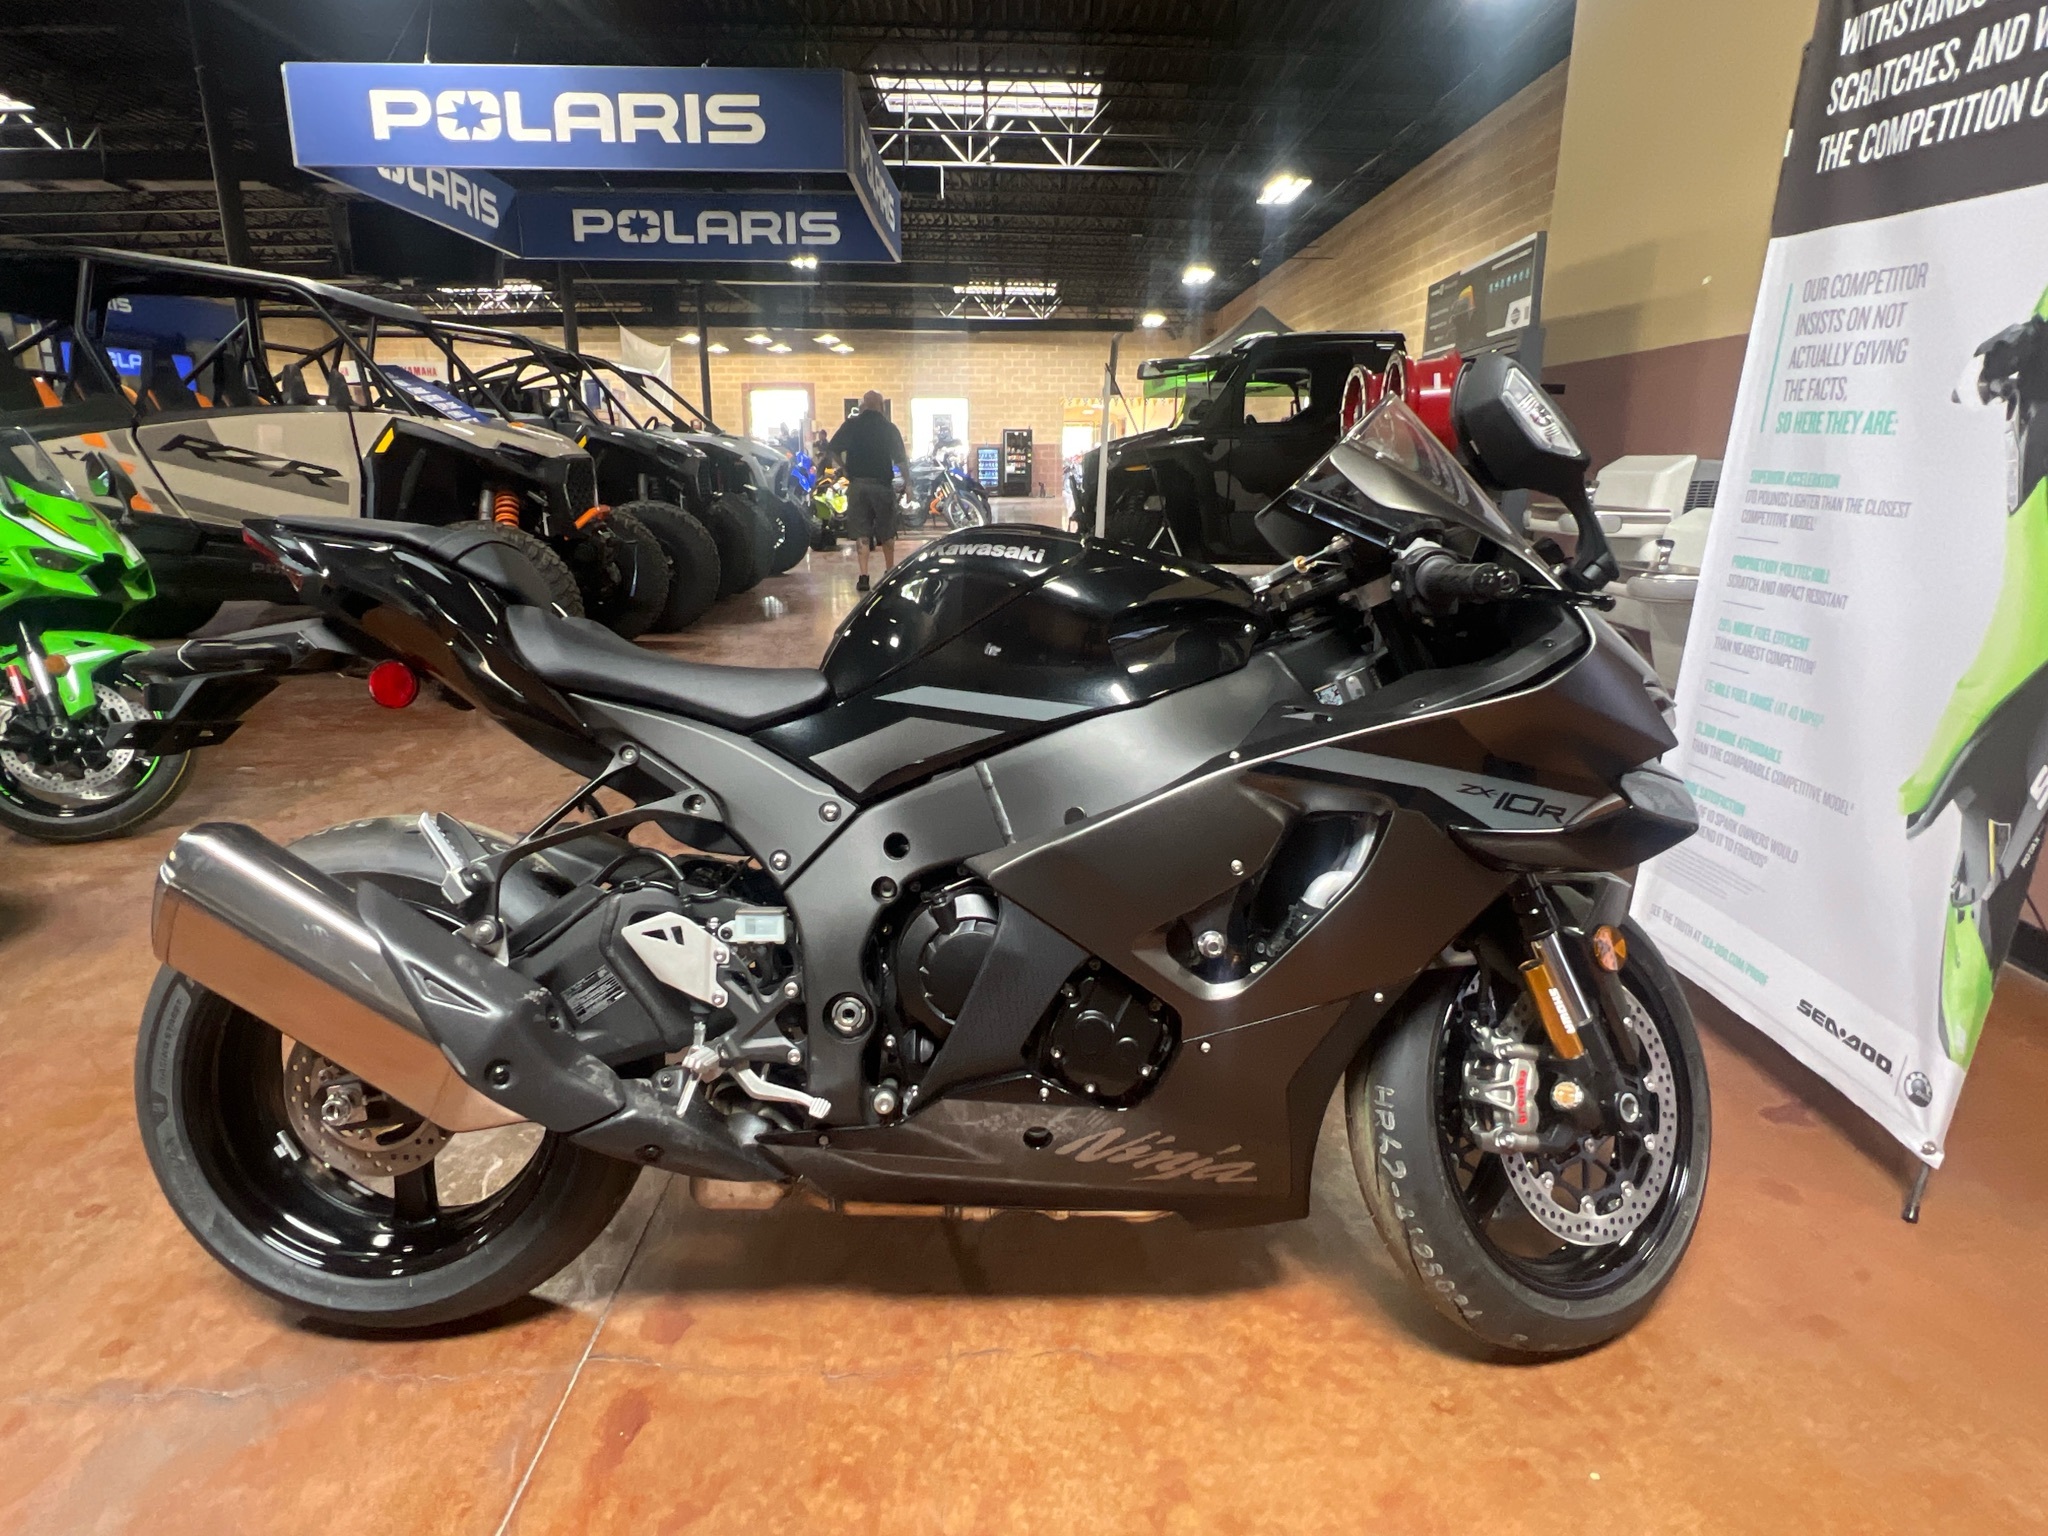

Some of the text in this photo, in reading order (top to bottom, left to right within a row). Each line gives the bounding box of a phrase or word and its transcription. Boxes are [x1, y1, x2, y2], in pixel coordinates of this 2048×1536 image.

[1840, 0, 1987, 56] WITHSTAN
[1826, 37, 1960, 117] SCRATCHES,
[1965, 13, 2030, 74] AND
[368, 90, 767, 145] POLARIS
[1816, 128, 1860, 174] THE
[1858, 76, 2031, 163] COMPETITION
[572, 209, 842, 245] POLARIS
[1802, 262, 1929, 304] OUR COMPETITOR
[1795, 302, 1909, 337] INSISTS ON NOT
[1787, 338, 1910, 370] ACTUALLY GIVING
[1783, 379, 1808, 402] THE
[1775, 410, 1899, 436] SO HERE THEY ARE:
[158, 434, 344, 487] RZR
[1741, 510, 1788, 528] COMPETITIVE
[1756, 490, 1788, 506] POUNDS
[1788, 493, 1820, 509] LIGHTER
[1820, 496, 1844, 512] THAN
[1845, 497, 1864, 514] THE
[1864, 498, 1912, 519] CLOSEST
[930, 543, 1046, 564] Kawasaki
[1726, 574, 1849, 611] SCRATCH AND IMPACT RESISTANT
[1732, 640, 1766, 662] NEAREST
[1709, 744, 1724, 761] THE
[1722, 749, 1772, 782] COMPARABLE
[1770, 769, 1823, 803] COMPETITIVE
[1456, 783, 1567, 824] ZX-10R
[1712, 812, 1739, 835] SPARK
[1738, 822, 1770, 851] OWNERS
[1769, 838, 1799, 864] WOULD
[1516, 1069, 1528, 1125] brembo
[1054, 1126, 1258, 1184] Ninja
